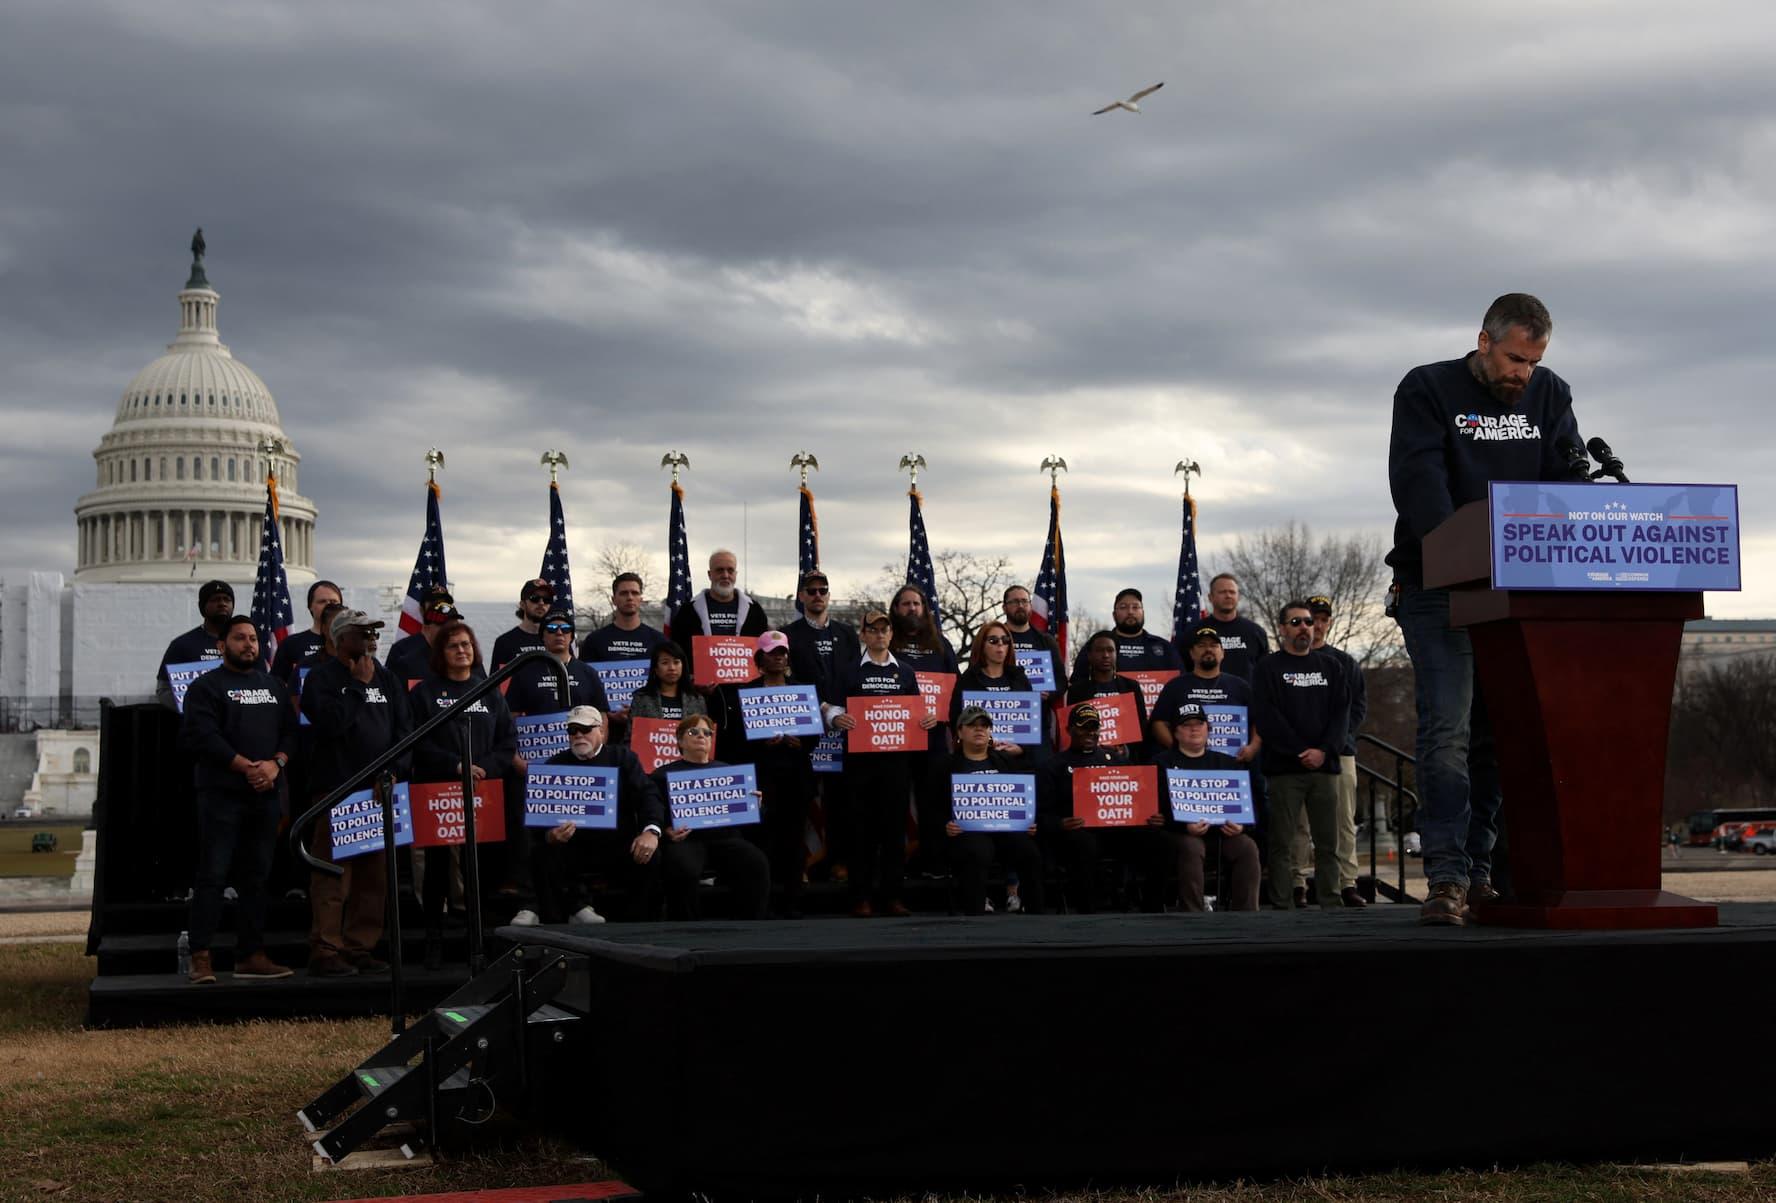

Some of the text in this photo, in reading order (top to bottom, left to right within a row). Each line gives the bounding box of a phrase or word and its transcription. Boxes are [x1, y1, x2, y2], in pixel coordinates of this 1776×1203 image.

[1455, 413, 1528, 428] COURAGE
[1473, 425, 1541, 440] AMERICA
[1569, 512, 1663, 521] NOT ON OUR WATCH
[1504, 524, 1728, 543] SPEAK OUT AGAINST
[1504, 545, 1730, 564] POLITICAL VIOLENCE
[709, 648, 752, 657] HONOR
[715, 658, 748, 667] YOUR
[1016, 658, 1033, 666] TOP
[618, 669, 645, 677] STOP
[717, 669, 749, 678] OATH
[1283, 672, 1322, 681] COURAGE
[1293, 679, 1328, 687] AMERICA
[227, 688, 271, 698] COURAGE
[918, 684, 941, 694] NOR
[240, 696, 278, 704] AMERICA
[607, 692, 633, 701] LENC
[742, 694, 798, 706] PUT A STOP
[994, 700, 1021, 708] STOP
[1178, 704, 1199, 715] NAVY
[744, 705, 809, 717] TO POLITICAL
[865, 710, 910, 720] HONOR
[746, 718, 796, 729] VIOLENCE
[1208, 714, 1233, 722] STOP
[517, 725, 536, 734] PUT
[547, 722, 568, 732] STO
[871, 722, 905, 732] YOUR
[518, 736, 569, 747] TO POLITI
[649, 732, 677, 744] HON
[872, 735, 905, 745] OATH
[655, 746, 680, 757] YOU
[528, 775, 595, 786] PUT A STOP
[670, 777, 734, 791] PUT A STOP
[1169, 778, 1229, 788] PUT A STOP
[954, 784, 1015, 793] PUT A STOP
[1090, 781, 1138, 793] HONOR
[527, 789, 605, 801] TO POLITICAL
[671, 789, 745, 805] TO POLITICAL
[1096, 795, 1133, 806] YOUR
[1171, 790, 1240, 801] TO POLITICAL
[428, 797, 483, 811] HONR
[954, 797, 1025, 806] TO POLITICAL
[331, 799, 383, 818] PUT A STO
[527, 804, 586, 815] VIOLENCE
[672, 805, 729, 818] VIOLENCE
[1172, 802, 1224, 813] VIOLENCE
[436, 811, 466, 824] YOU
[954, 810, 1010, 820] VIOLENCE
[1097, 808, 1133, 820] OATH
[332, 823, 347, 833] TO
[437, 825, 466, 838] OAT
[333, 828, 384, 847] VIOLENCE
